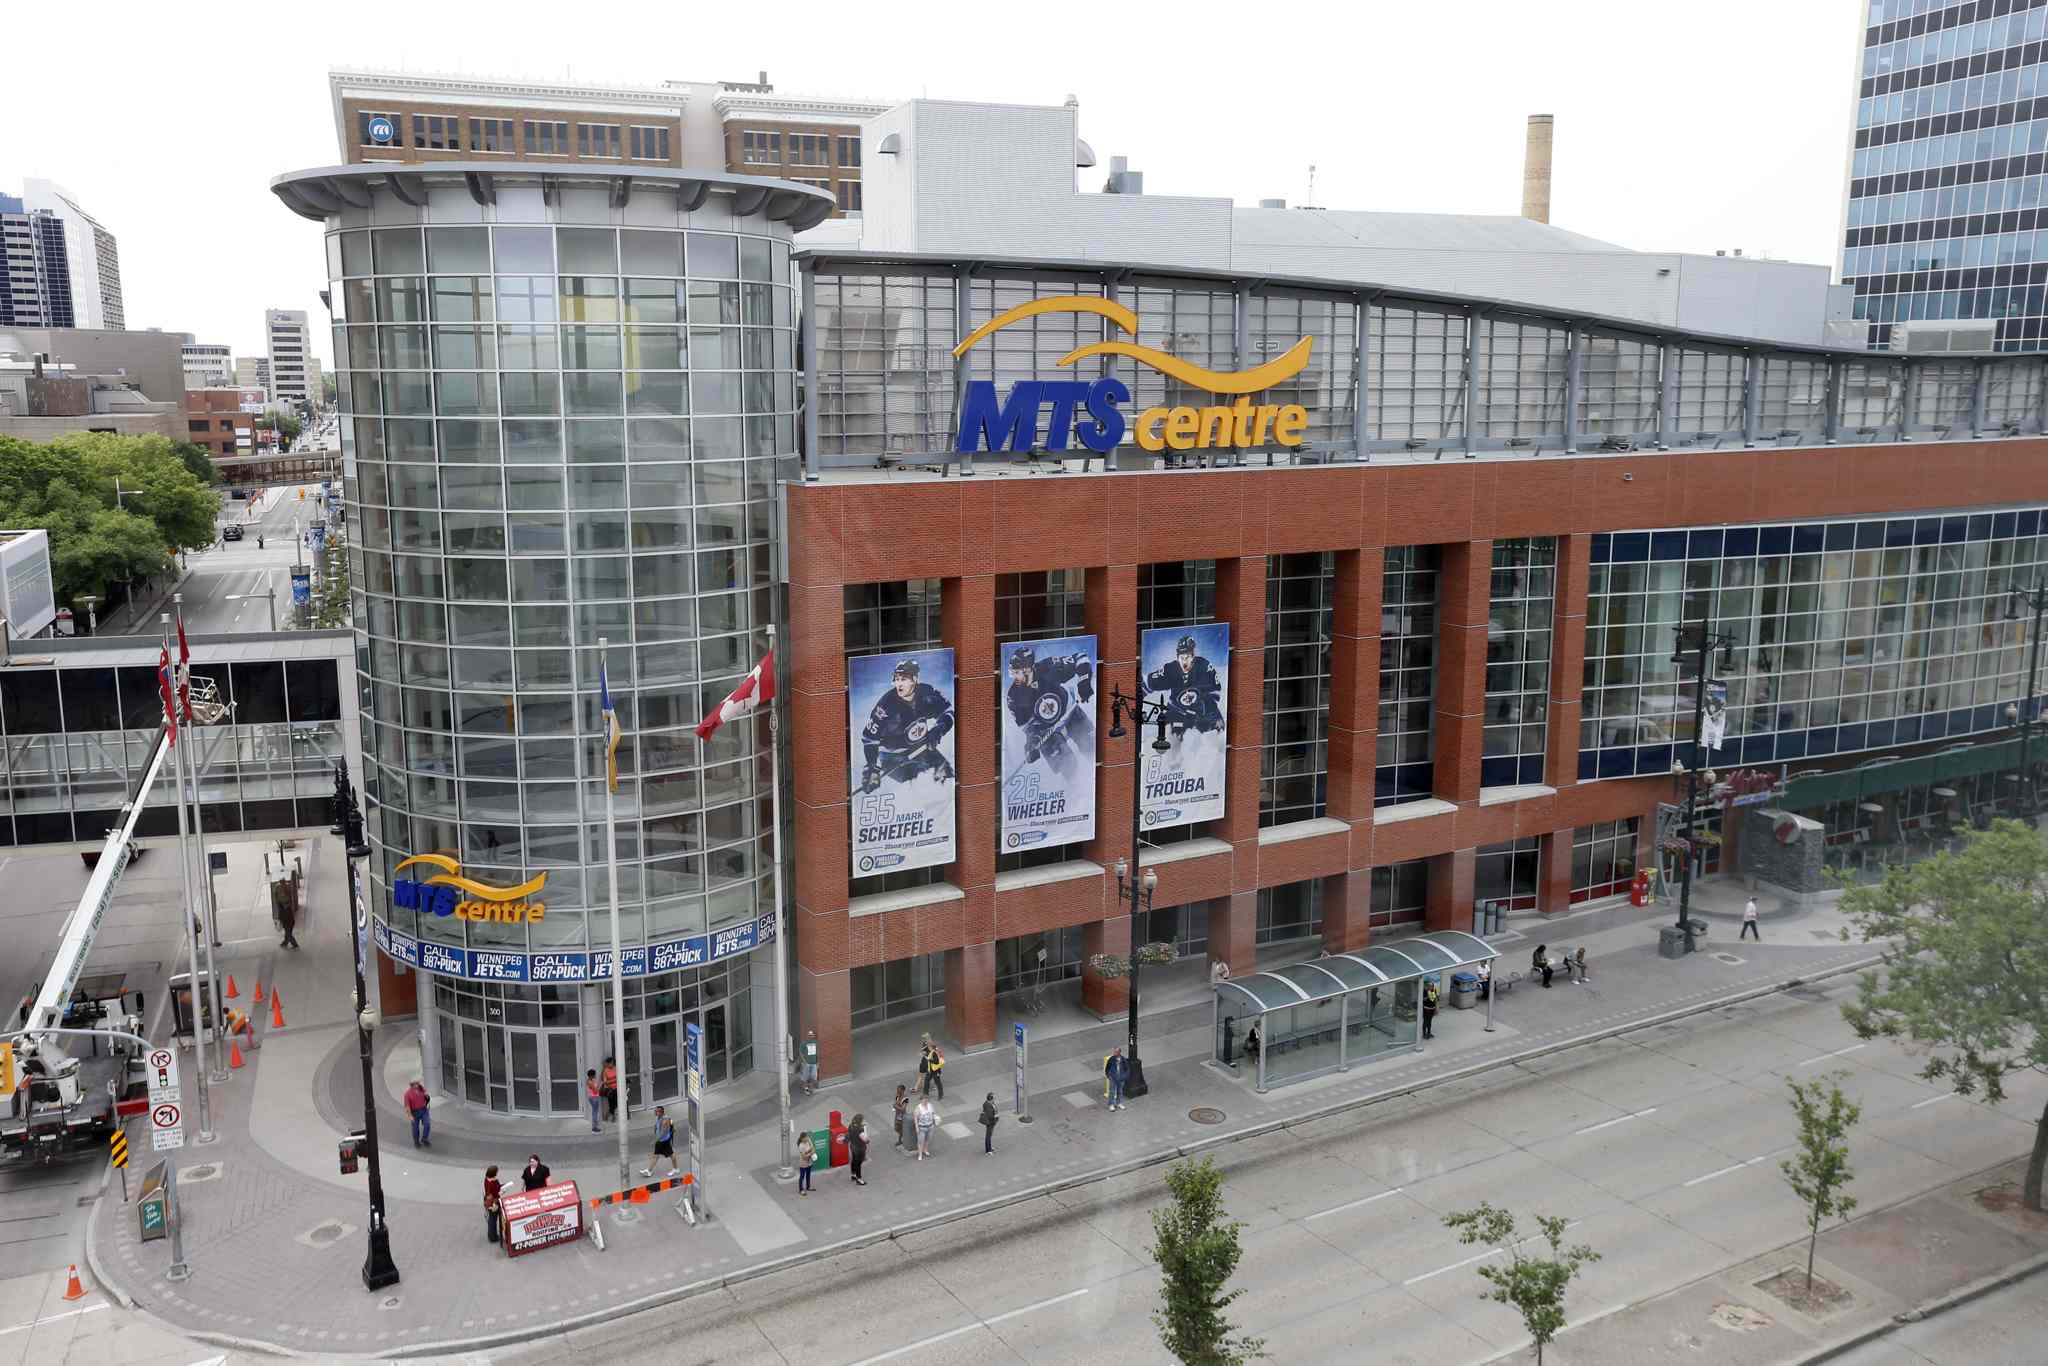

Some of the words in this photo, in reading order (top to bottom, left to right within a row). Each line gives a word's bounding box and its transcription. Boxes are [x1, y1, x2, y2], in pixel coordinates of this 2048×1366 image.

[957, 377, 1131, 453] MTS
[1135, 395, 1309, 451] centre
[1008, 772, 1041, 806] 26
[1145, 776, 1205, 799] TROUBA
[1038, 790, 1065, 801] BLAKE
[860, 793, 896, 826] 55
[896, 810, 924, 823] MARK
[1007, 798, 1066, 821] WHEELER
[858, 817, 935, 844] SCHEIFELE
[395, 880, 457, 917] MTS
[454, 901, 546, 923] centre
[716, 923, 753, 942] WINNIPEG
[424, 944, 452, 959] CALL
[594, 949, 644, 964] WINIPEG
[655, 942, 689, 957] CALL
[476, 953, 522, 965] WINNIPEG
[534, 956, 573, 966] CALL
[489, 1007, 500, 1015] 300
[515, 1237, 547, 1250] 47-POWER
